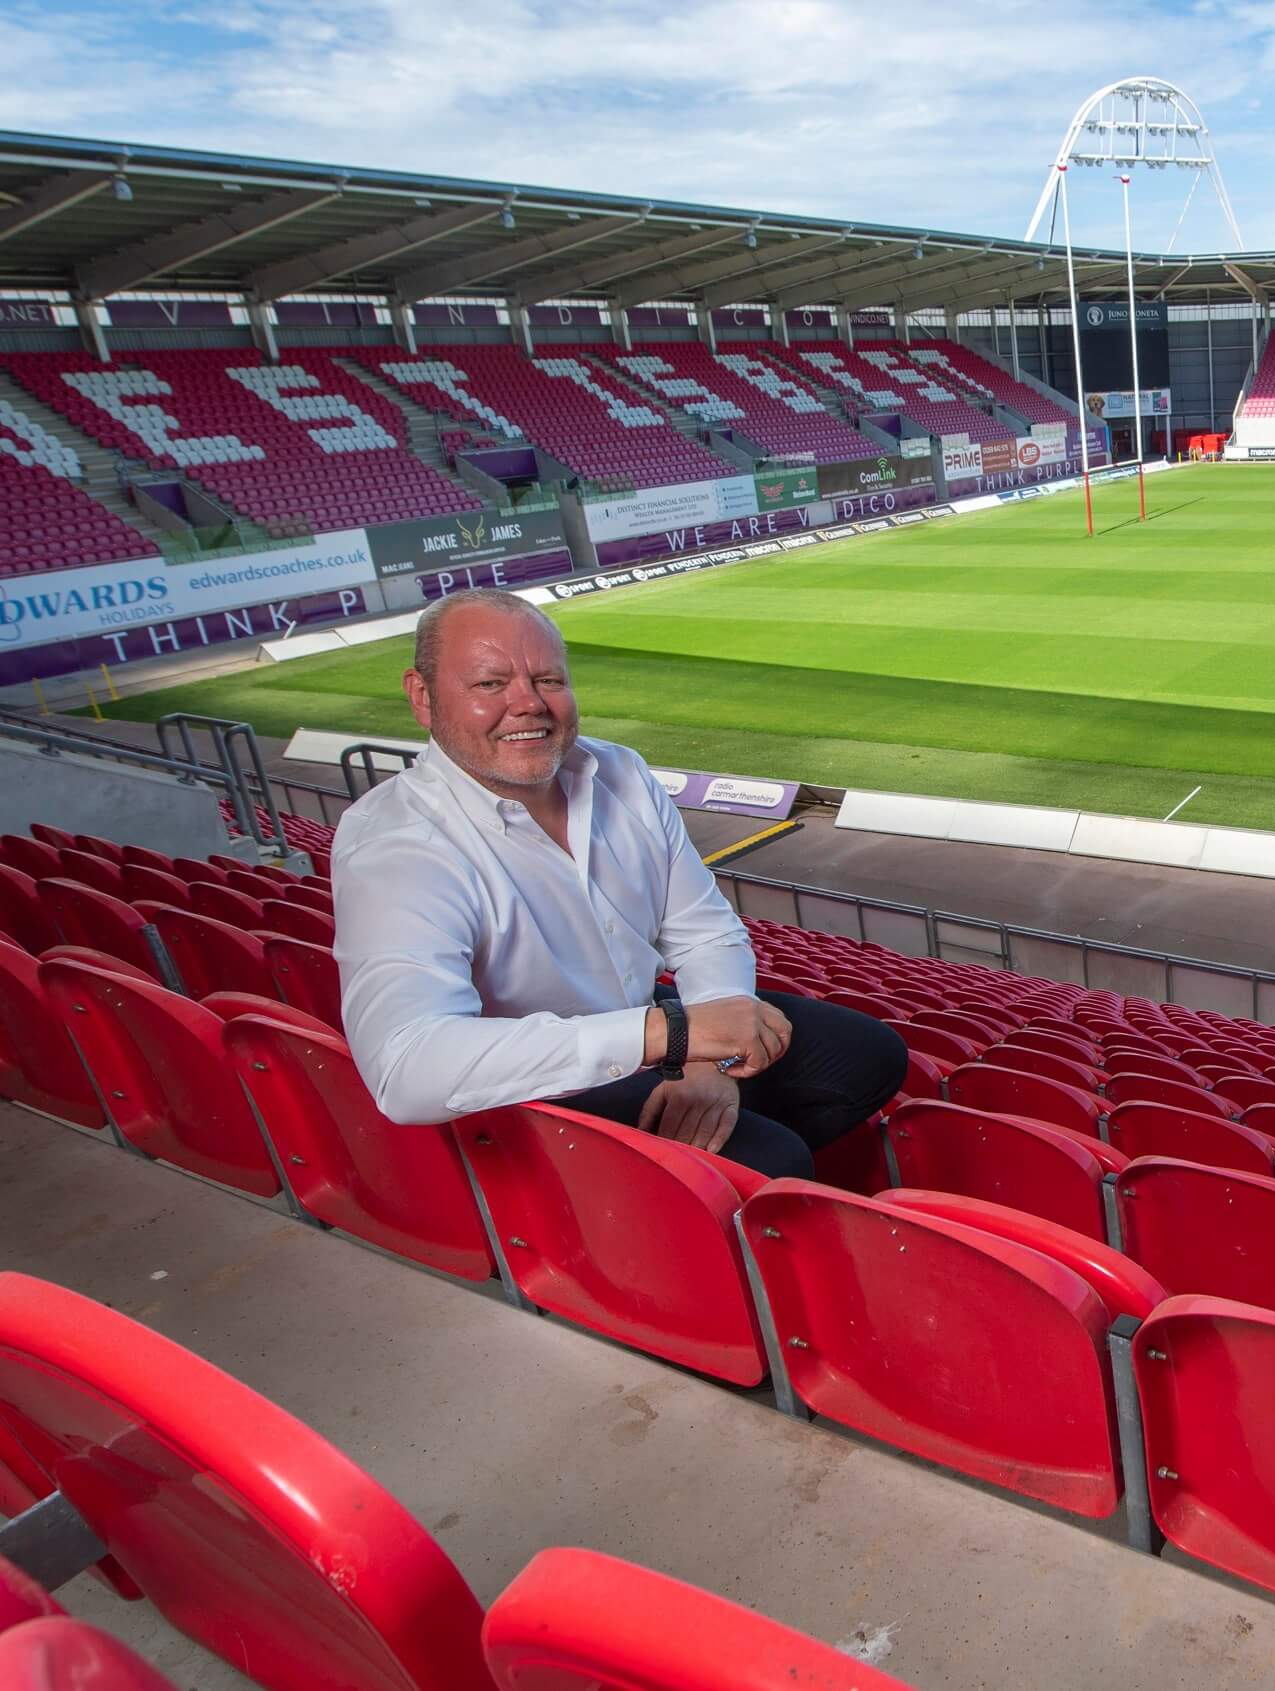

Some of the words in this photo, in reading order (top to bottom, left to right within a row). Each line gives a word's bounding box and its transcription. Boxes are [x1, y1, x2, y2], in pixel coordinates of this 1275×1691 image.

[1129, 309, 1160, 318] ONETA
[860, 466, 897, 484] ComLink
[976, 470, 1025, 493] THINK
[1036, 460, 1083, 482] PURPL
[423, 533, 459, 552] JACKIE
[490, 523, 522, 542] JAMES
[665, 526, 706, 551] WE
[730, 513, 777, 541] ARE
[189, 550, 367, 590] edwardscoaches.co.uk
[100, 602, 175, 626] HOLIDAYS
[103, 602, 295, 662] THINK
[711, 788, 776, 804] carmarthenshire
[714, 781, 733, 791] radio
